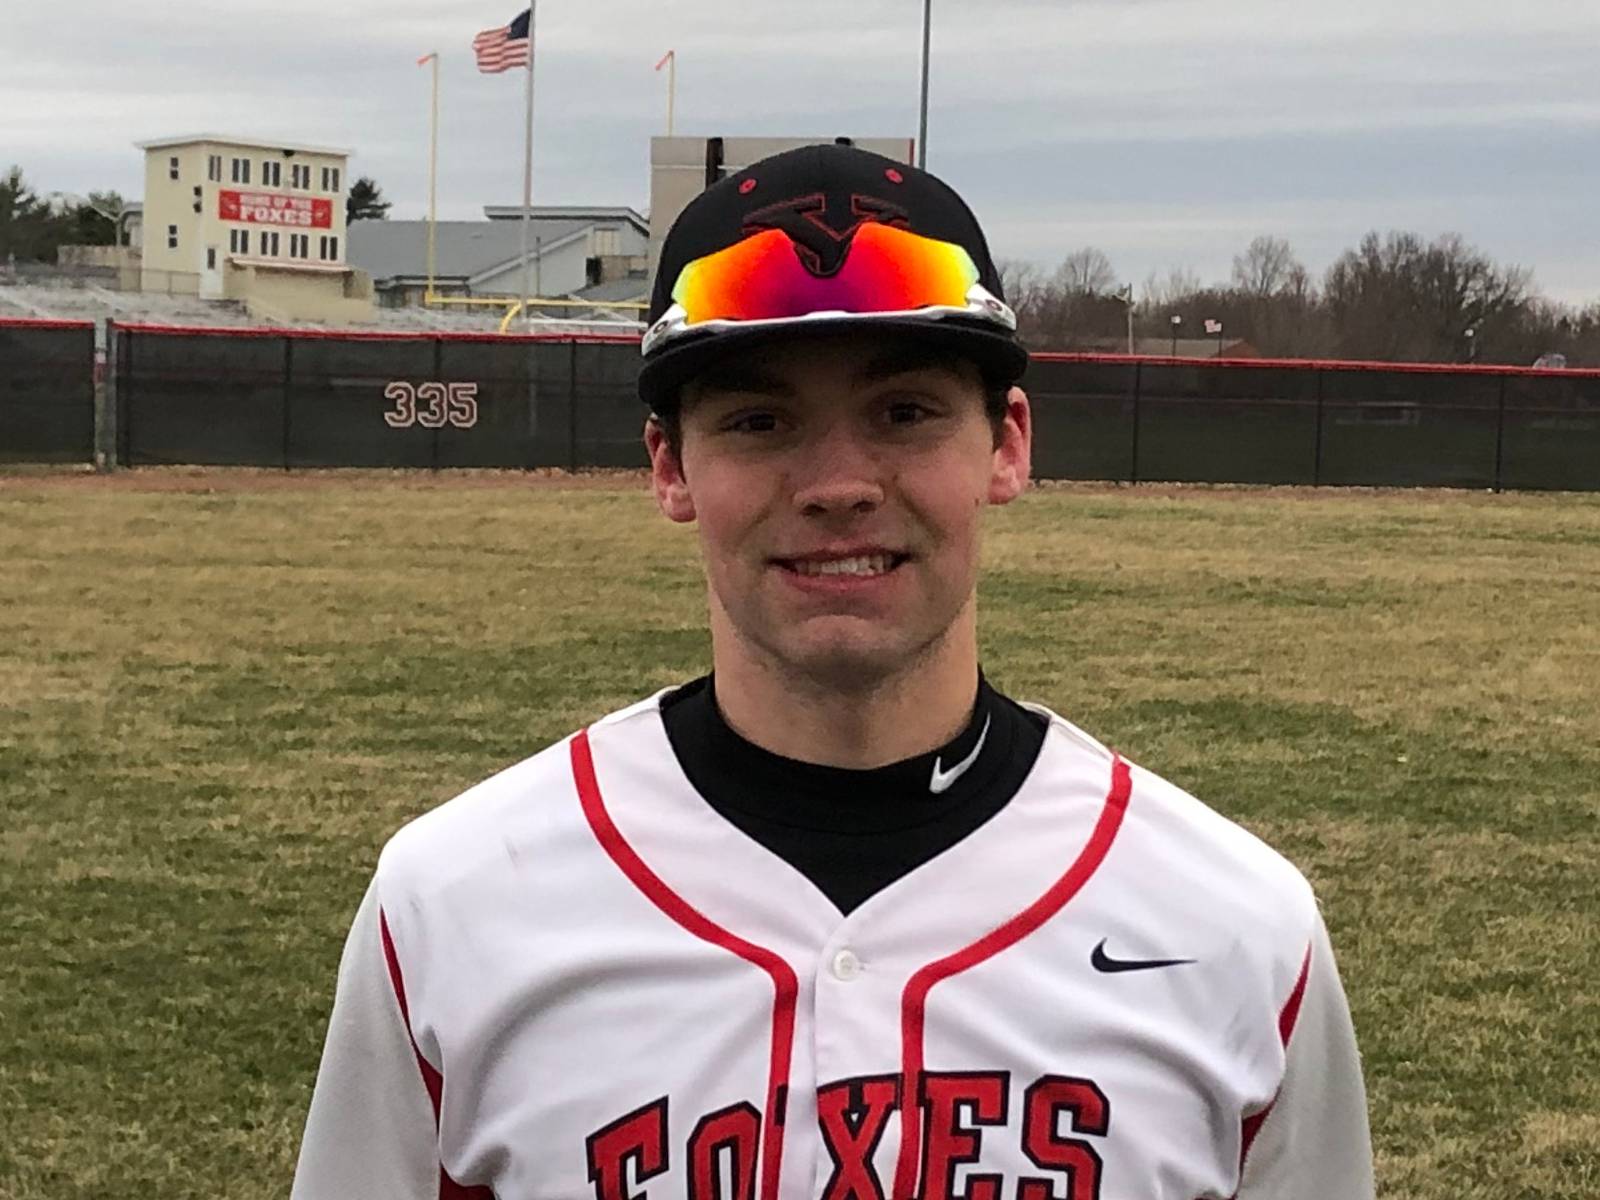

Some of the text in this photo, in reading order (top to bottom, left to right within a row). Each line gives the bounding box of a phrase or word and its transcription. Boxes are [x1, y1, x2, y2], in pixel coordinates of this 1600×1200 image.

[240, 205, 312, 226] FOXES
[384, 381, 478, 428] 335
[585, 1070, 1111, 1200] FOXES
